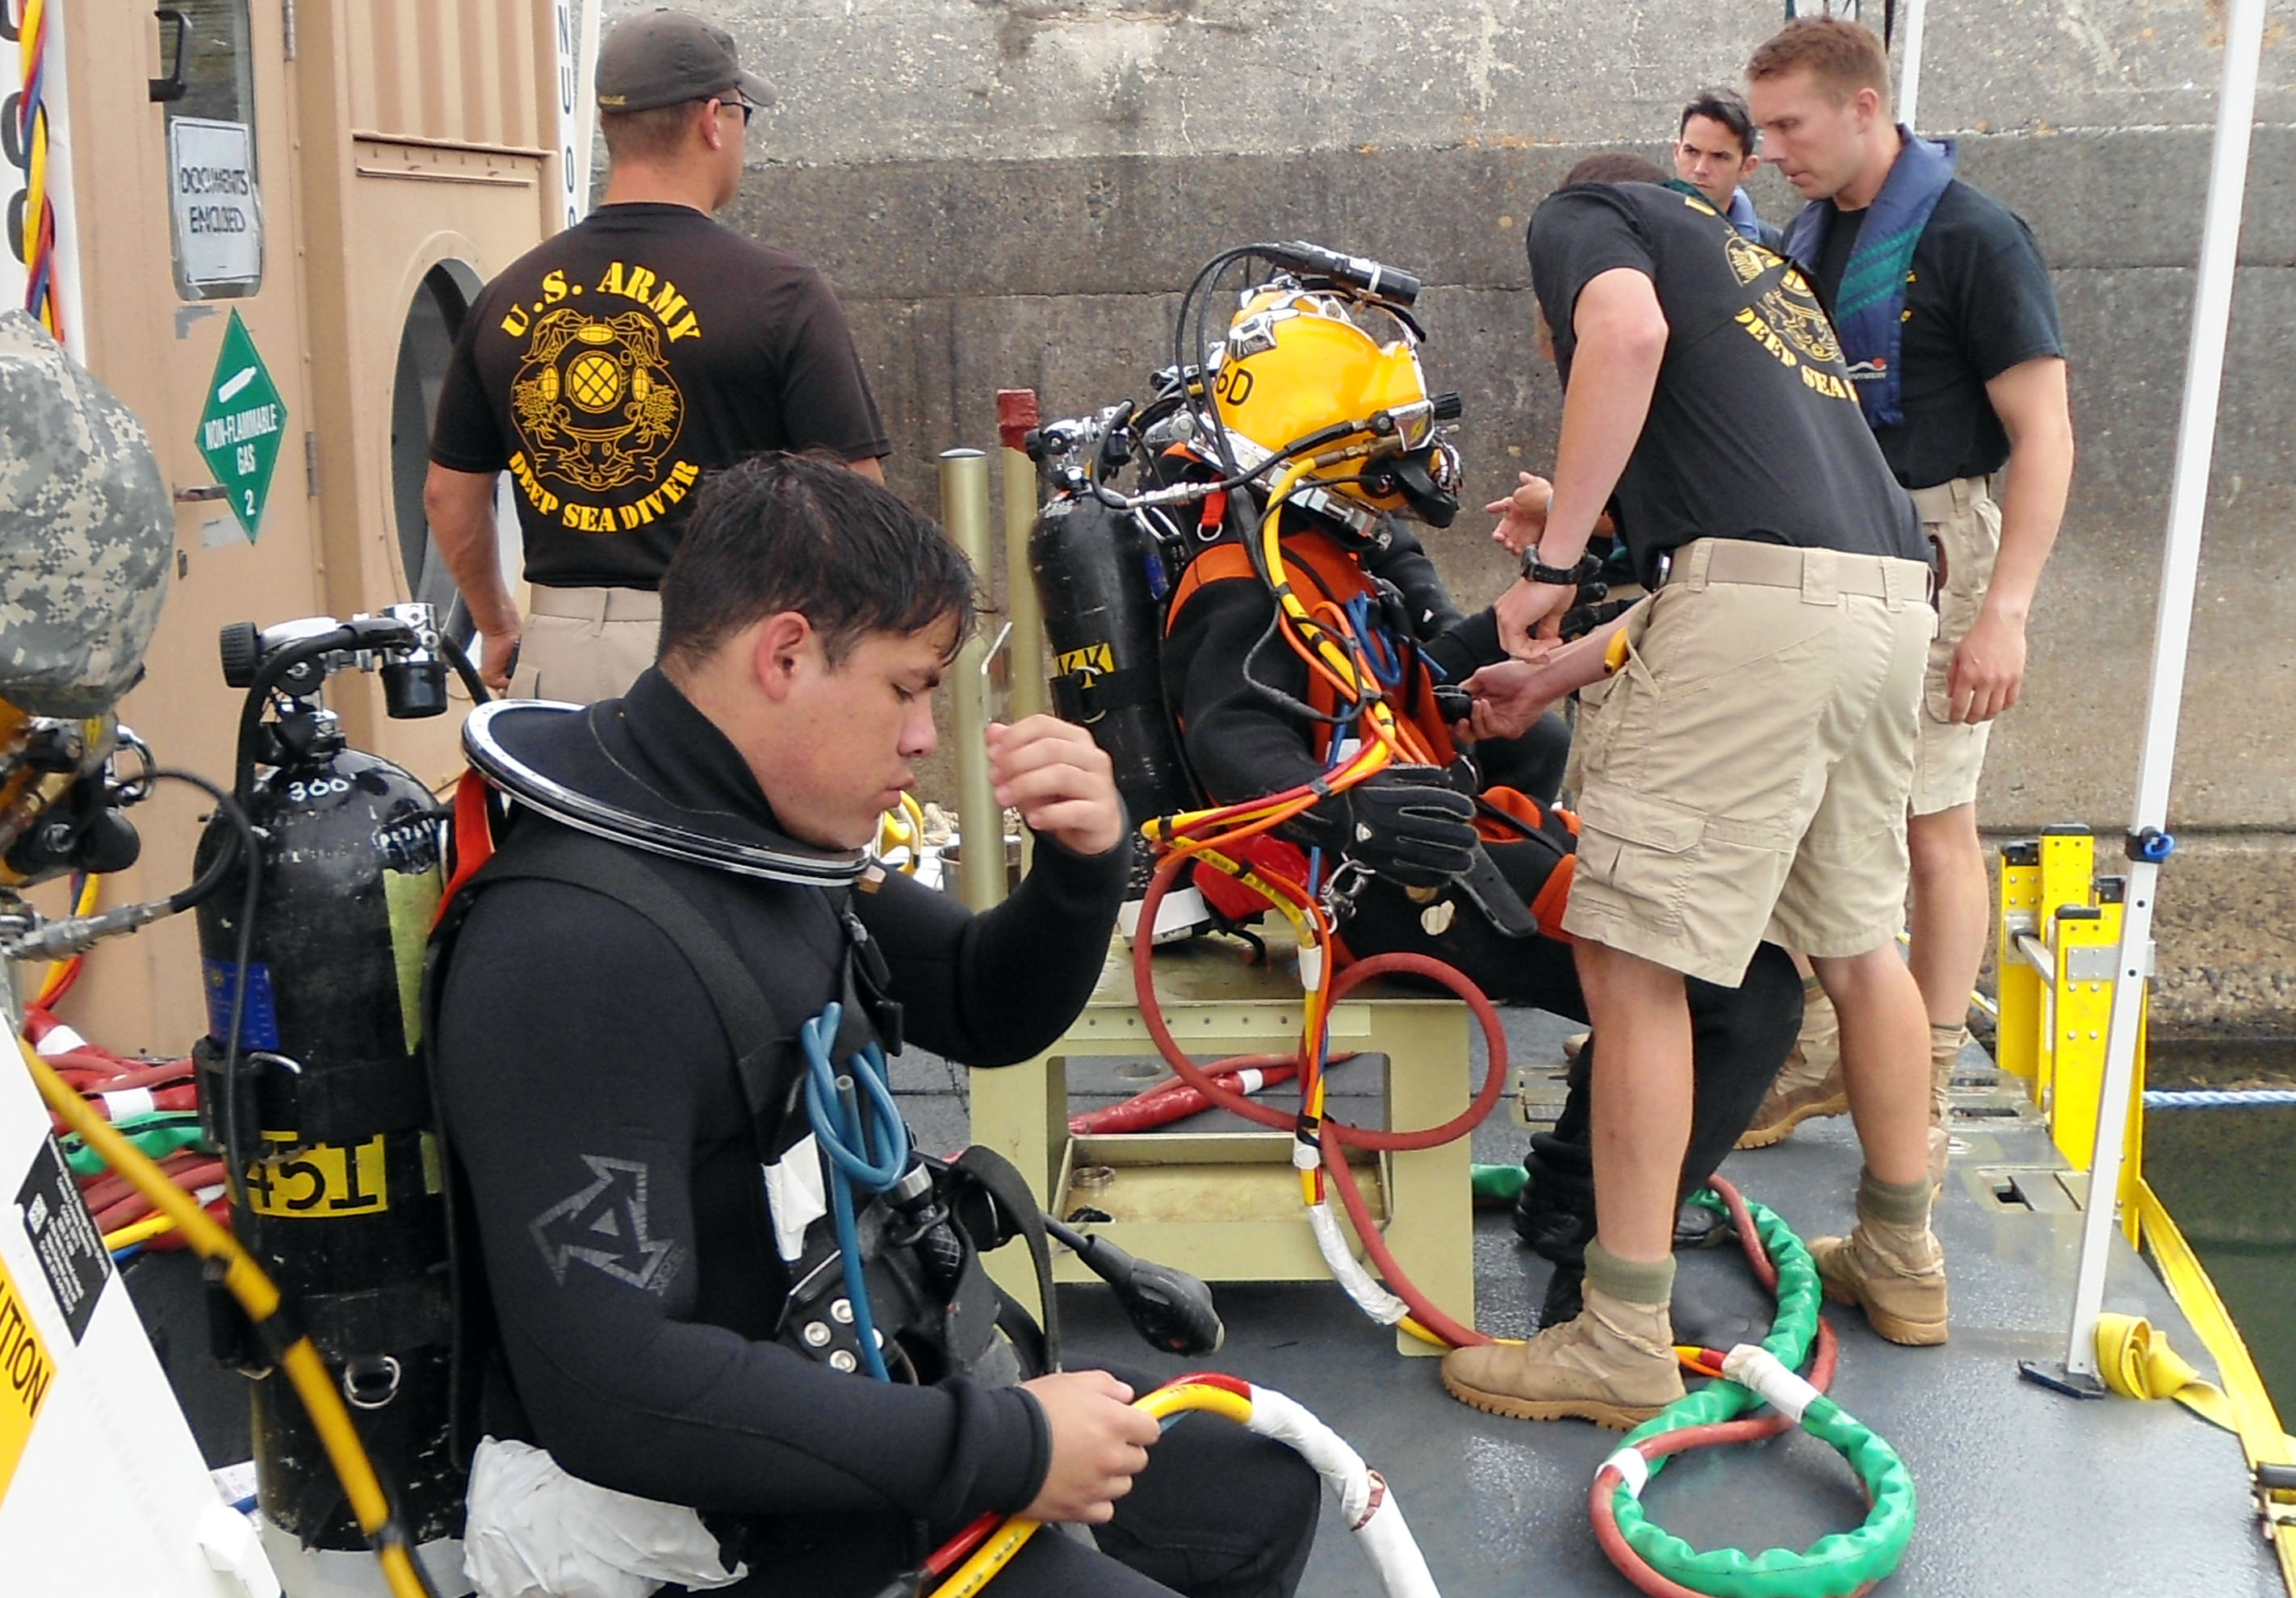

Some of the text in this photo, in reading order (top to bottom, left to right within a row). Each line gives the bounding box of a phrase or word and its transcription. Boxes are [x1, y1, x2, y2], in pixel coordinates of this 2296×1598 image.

[180, 165, 249, 195] DOCUMENTS
[189, 206, 246, 233] ENCLOSED
[500, 261, 702, 343] U.S. ARMY
[1734, 306, 1797, 368] DEEP
[1800, 365, 1847, 399] SEA
[205, 403, 279, 451] NON-FLAMMABLE
[237, 443, 257, 476] GAS
[245, 488, 256, 517] 2
[508, 450, 700, 533] DEEP SEA DIVER
